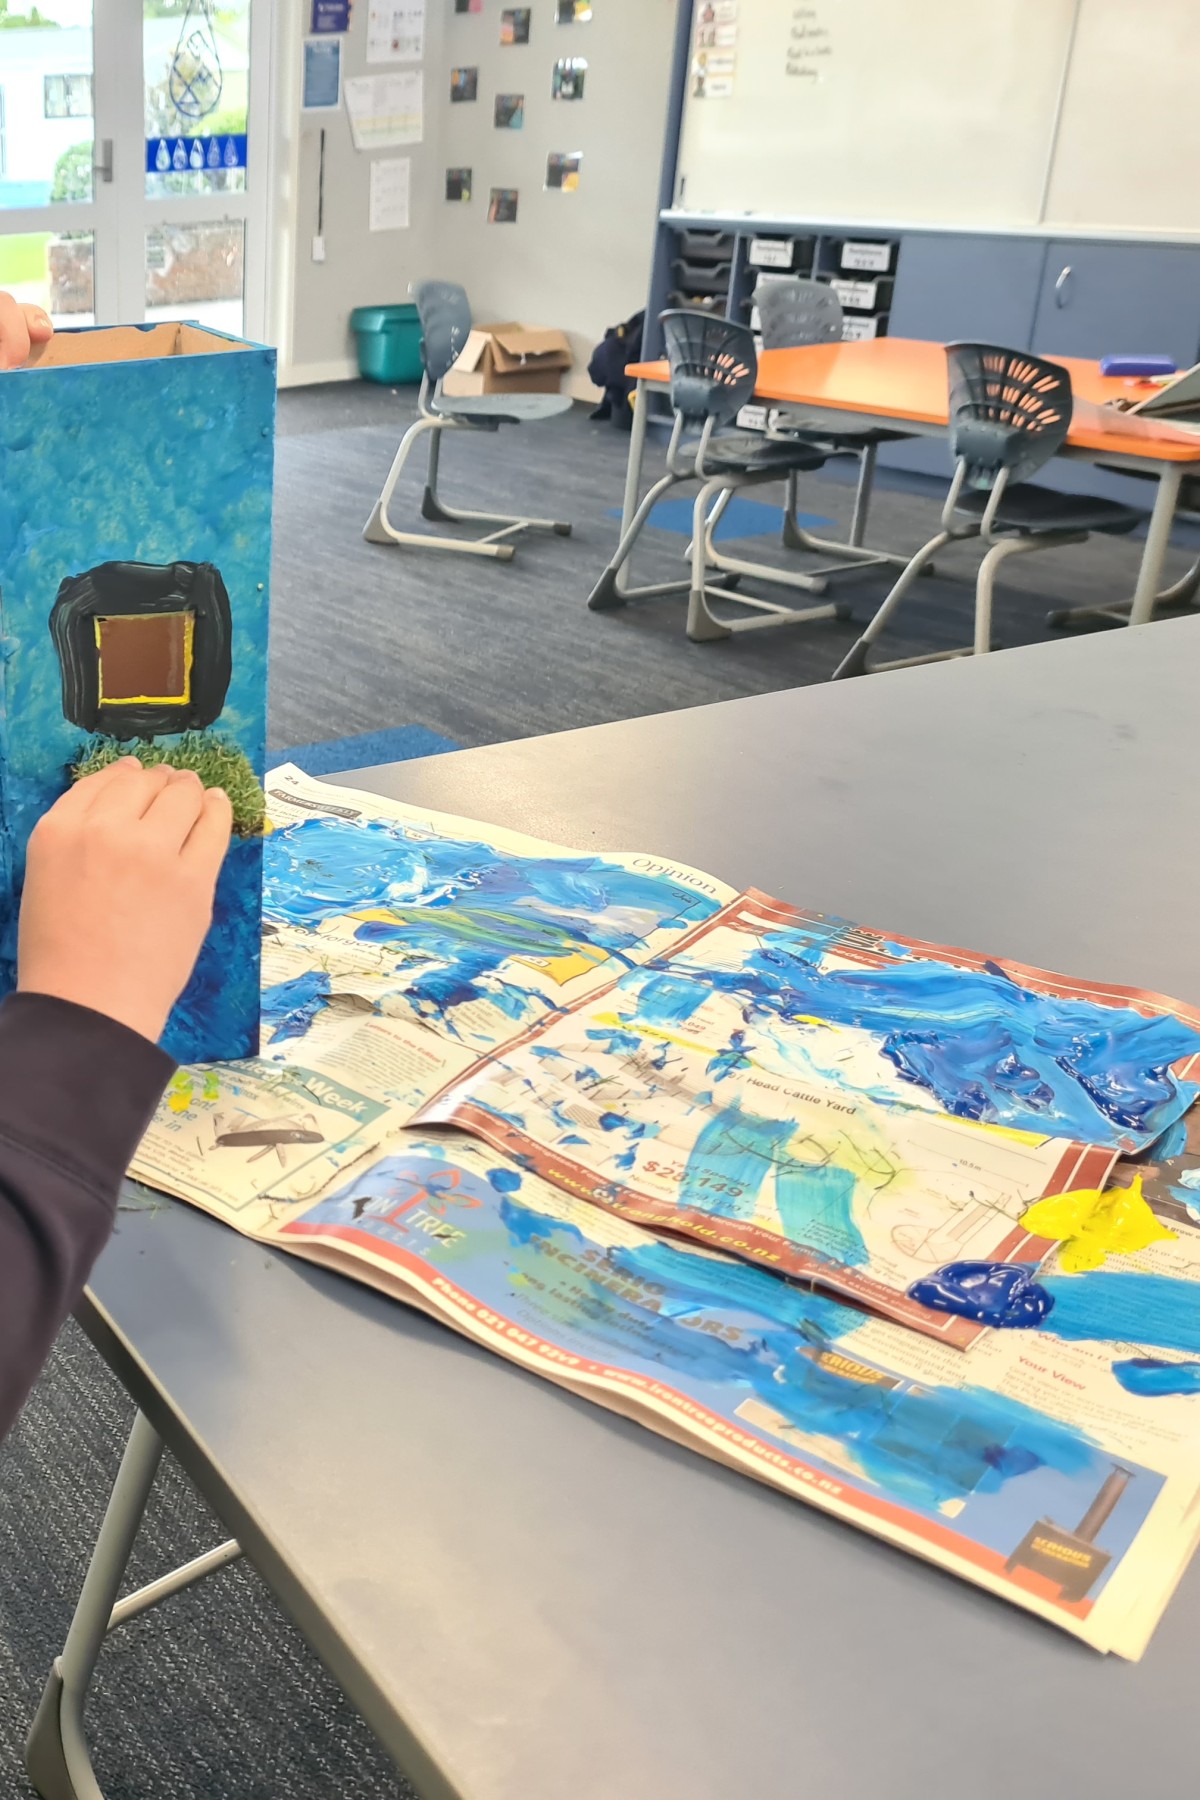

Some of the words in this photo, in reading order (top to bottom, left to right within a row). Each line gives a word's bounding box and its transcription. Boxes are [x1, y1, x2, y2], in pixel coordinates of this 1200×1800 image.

[632, 858, 717, 895] Opinion
[302, 1076, 368, 1114] Week
[746, 1077, 781, 1092] Head
[783, 1086, 822, 1105] Cattle
[825, 1098, 857, 1116] Yard
[642, 1160, 744, 1198] $28,149
[405, 1207, 468, 1248] TREE
[432, 1277, 476, 1312] Phone
[476, 1308, 507, 1330] 021
[506, 1327, 538, 1347] 047
[1018, 1355, 1048, 1374] Your
[1052, 1370, 1086, 1391] View
